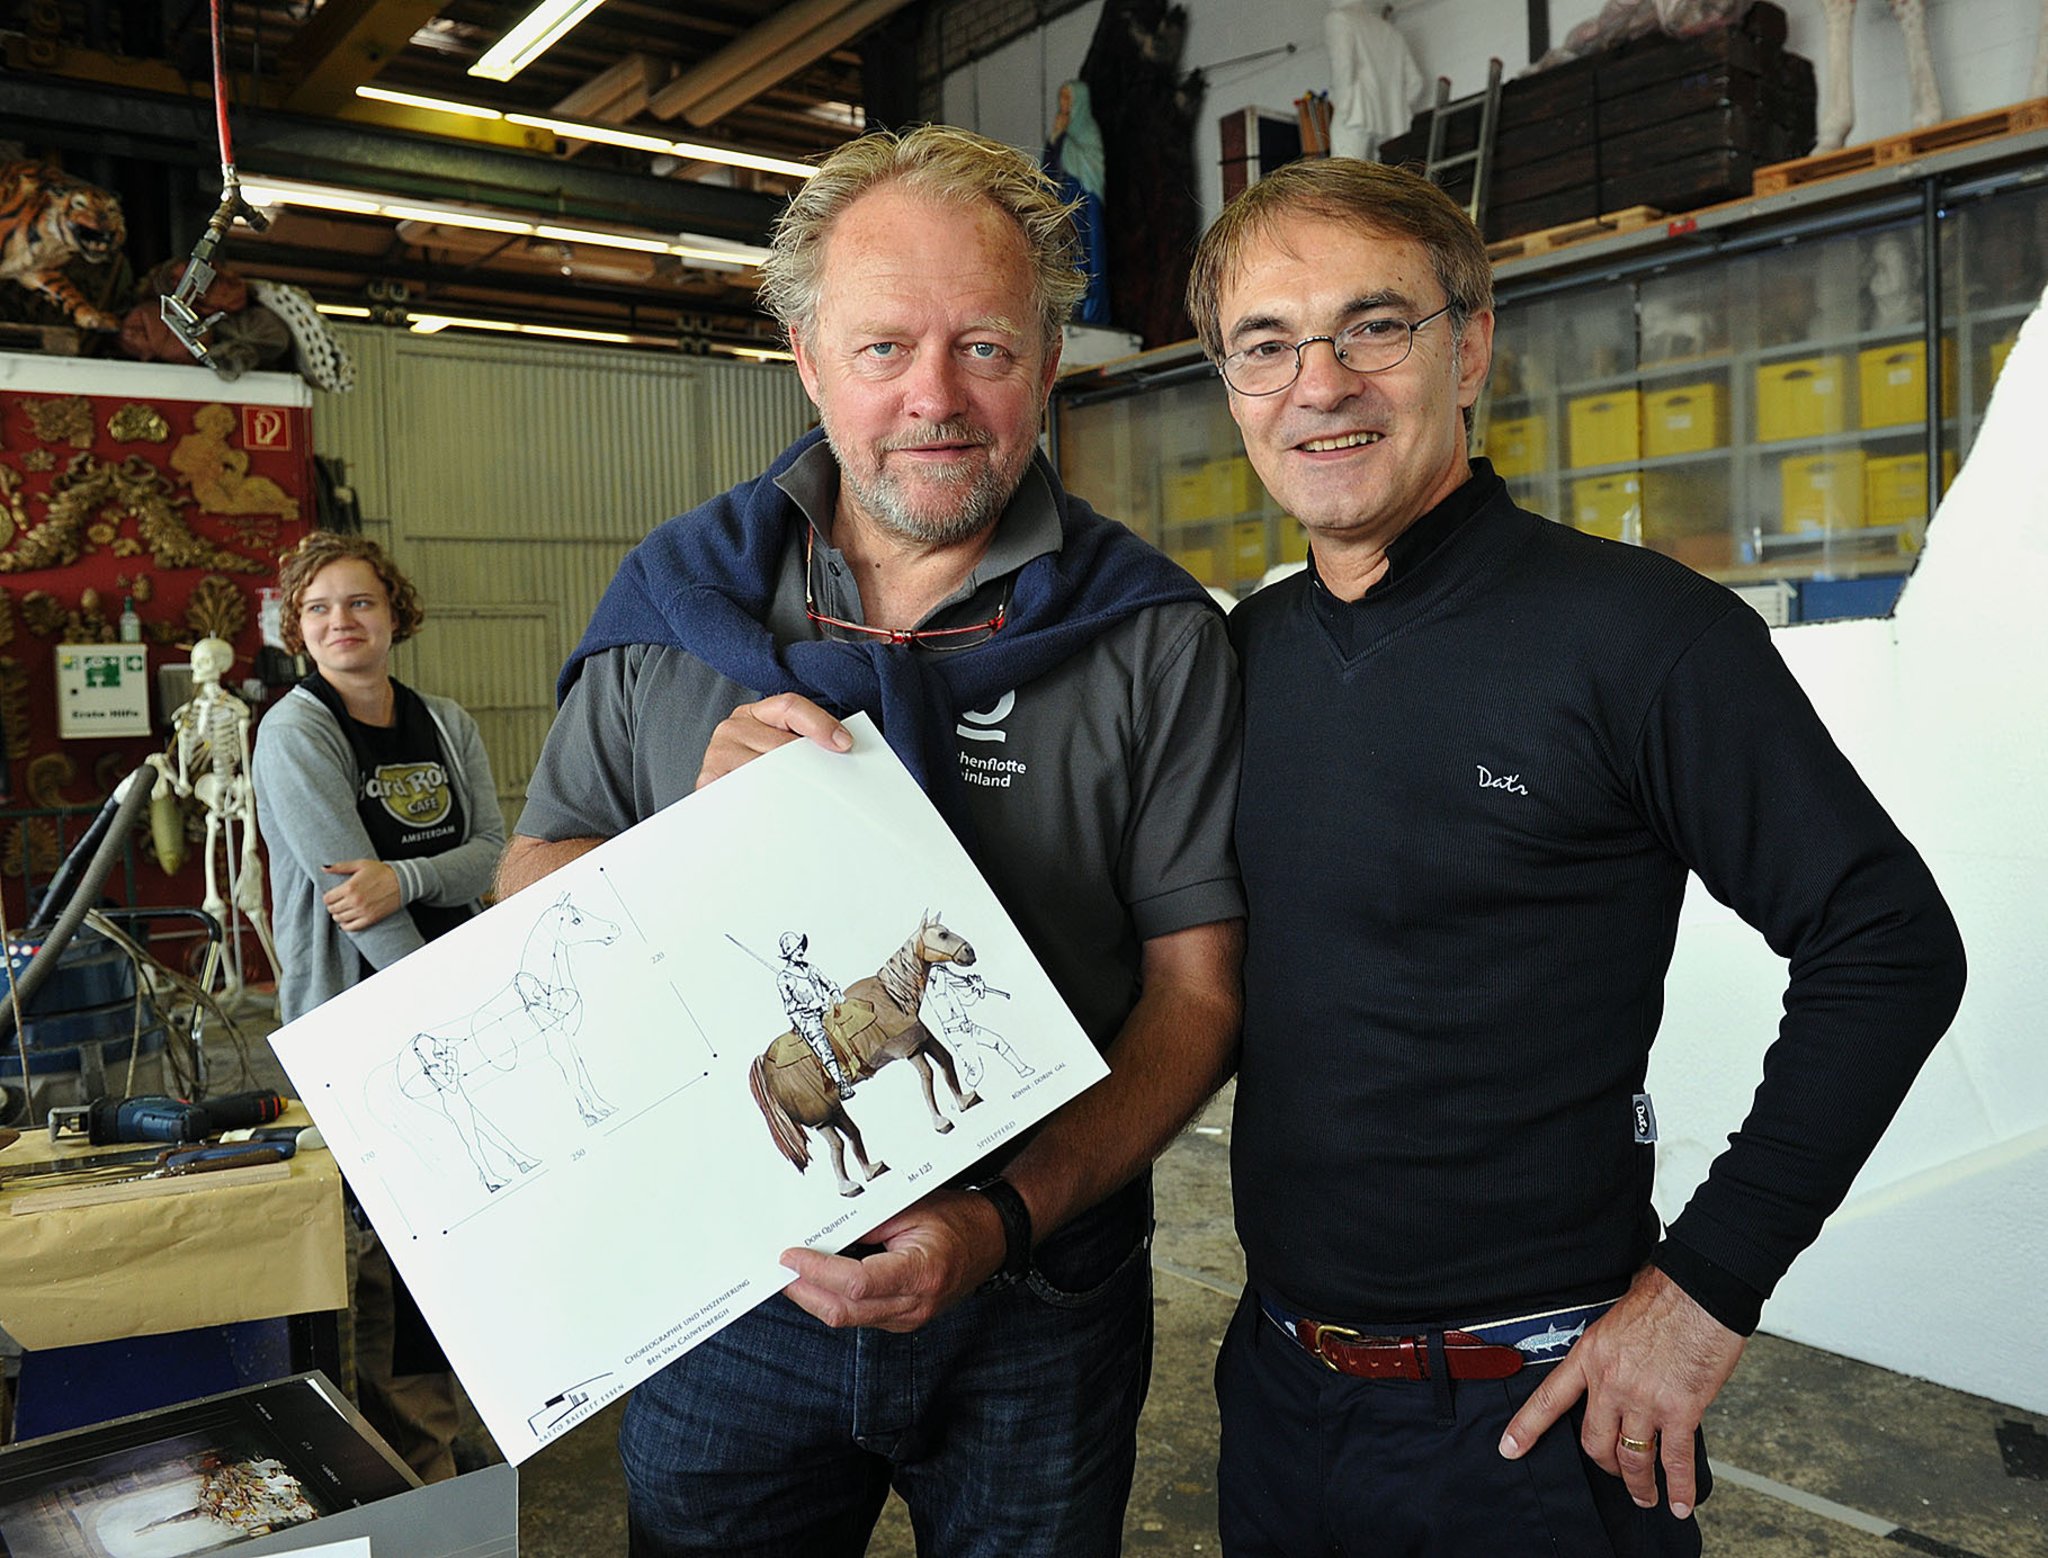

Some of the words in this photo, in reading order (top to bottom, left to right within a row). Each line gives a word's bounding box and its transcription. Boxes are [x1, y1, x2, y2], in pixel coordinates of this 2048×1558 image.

[958, 751, 1027, 775] henflotte
[962, 768, 1011, 787] inland
[401, 825, 456, 844] AMSTERDAM
[682, 1311, 700, 1326] UND
[661, 1343, 678, 1355] VAN
